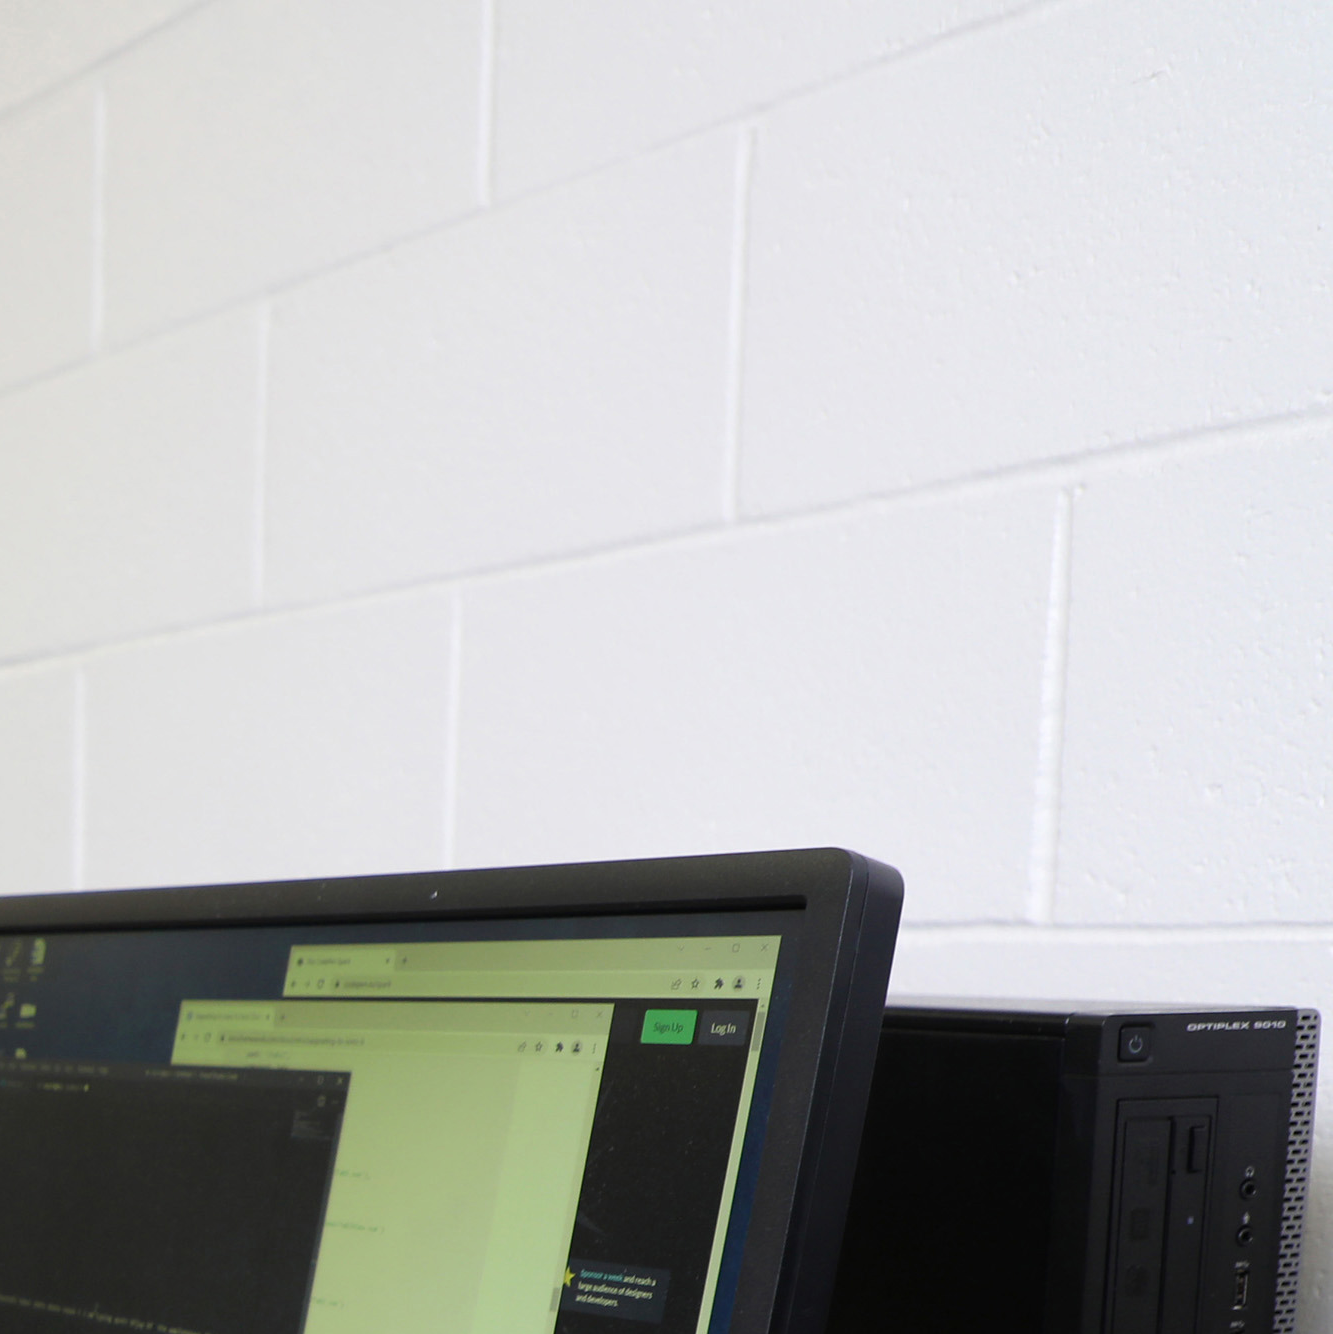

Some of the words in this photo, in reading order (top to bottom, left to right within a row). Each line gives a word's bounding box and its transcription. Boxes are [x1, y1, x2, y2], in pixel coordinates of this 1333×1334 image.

[654, 1022, 670, 1034] Sign
[672, 1022, 684, 1033] Up
[710, 1022, 726, 1036] Log
[726, 1023, 736, 1033] In
[1187, 1021, 1250, 1031] OPTIPLEX
[623, 1275, 635, 1284] and
[577, 1281, 593, 1292] large
[593, 1284, 619, 1295] audience
[625, 1288, 653, 1299] designers
[575, 1294, 588, 1302] and
